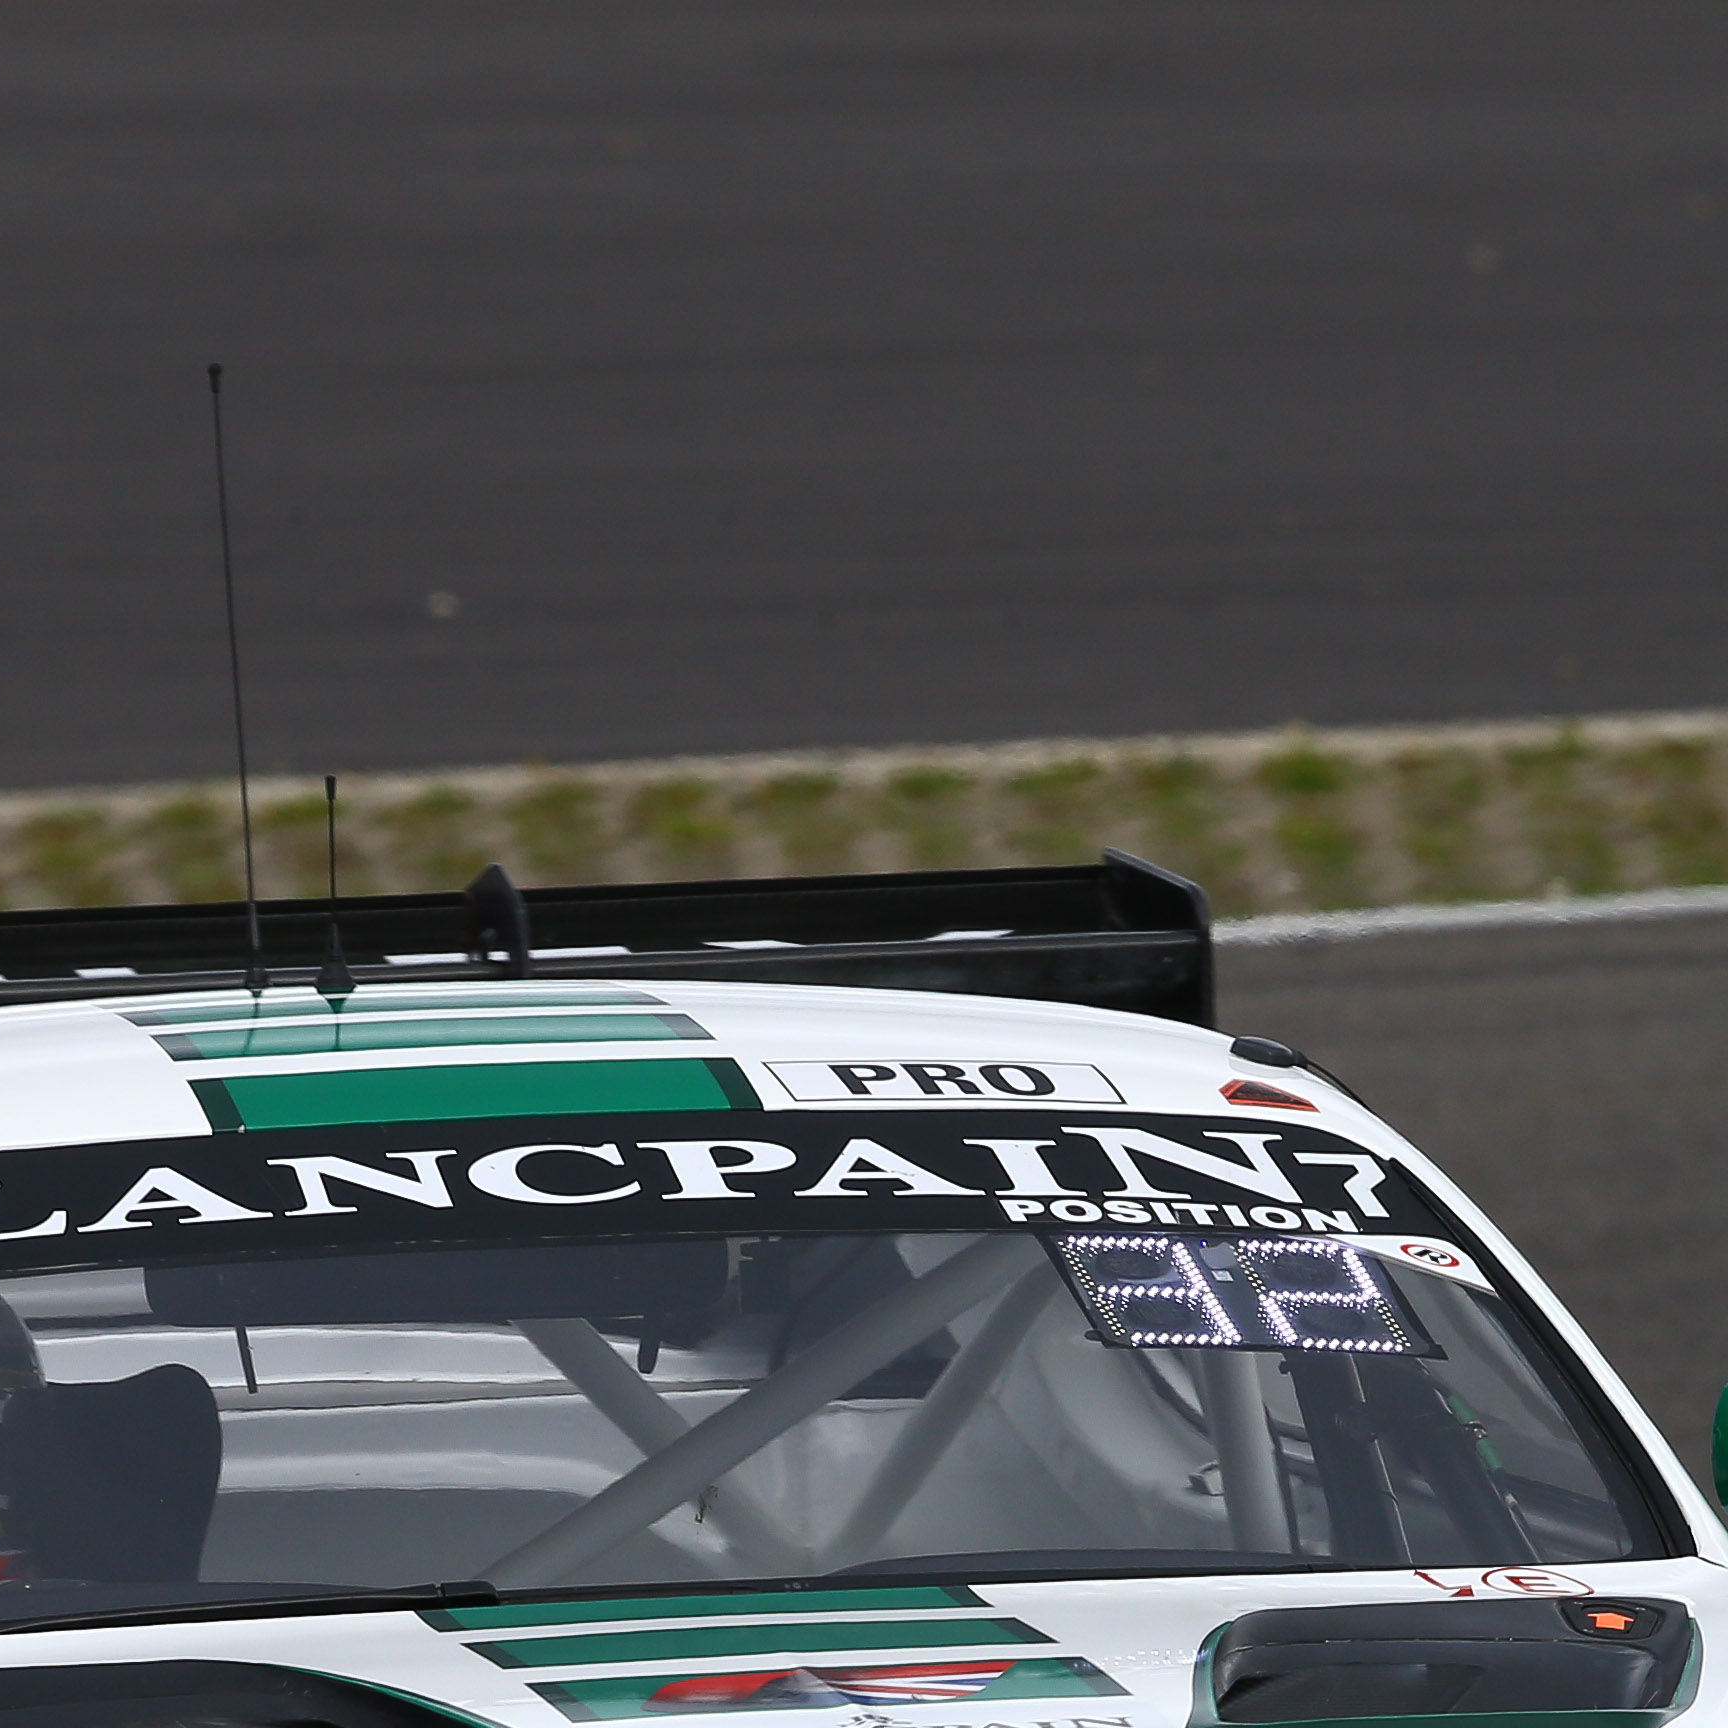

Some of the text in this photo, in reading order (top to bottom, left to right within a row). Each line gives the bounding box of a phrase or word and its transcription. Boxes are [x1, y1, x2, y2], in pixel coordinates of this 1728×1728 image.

[834, 1062, 1057, 1097] PRO
[1292, 1152, 1391, 1218] 7
[999, 1199, 1363, 1233] POSITION
